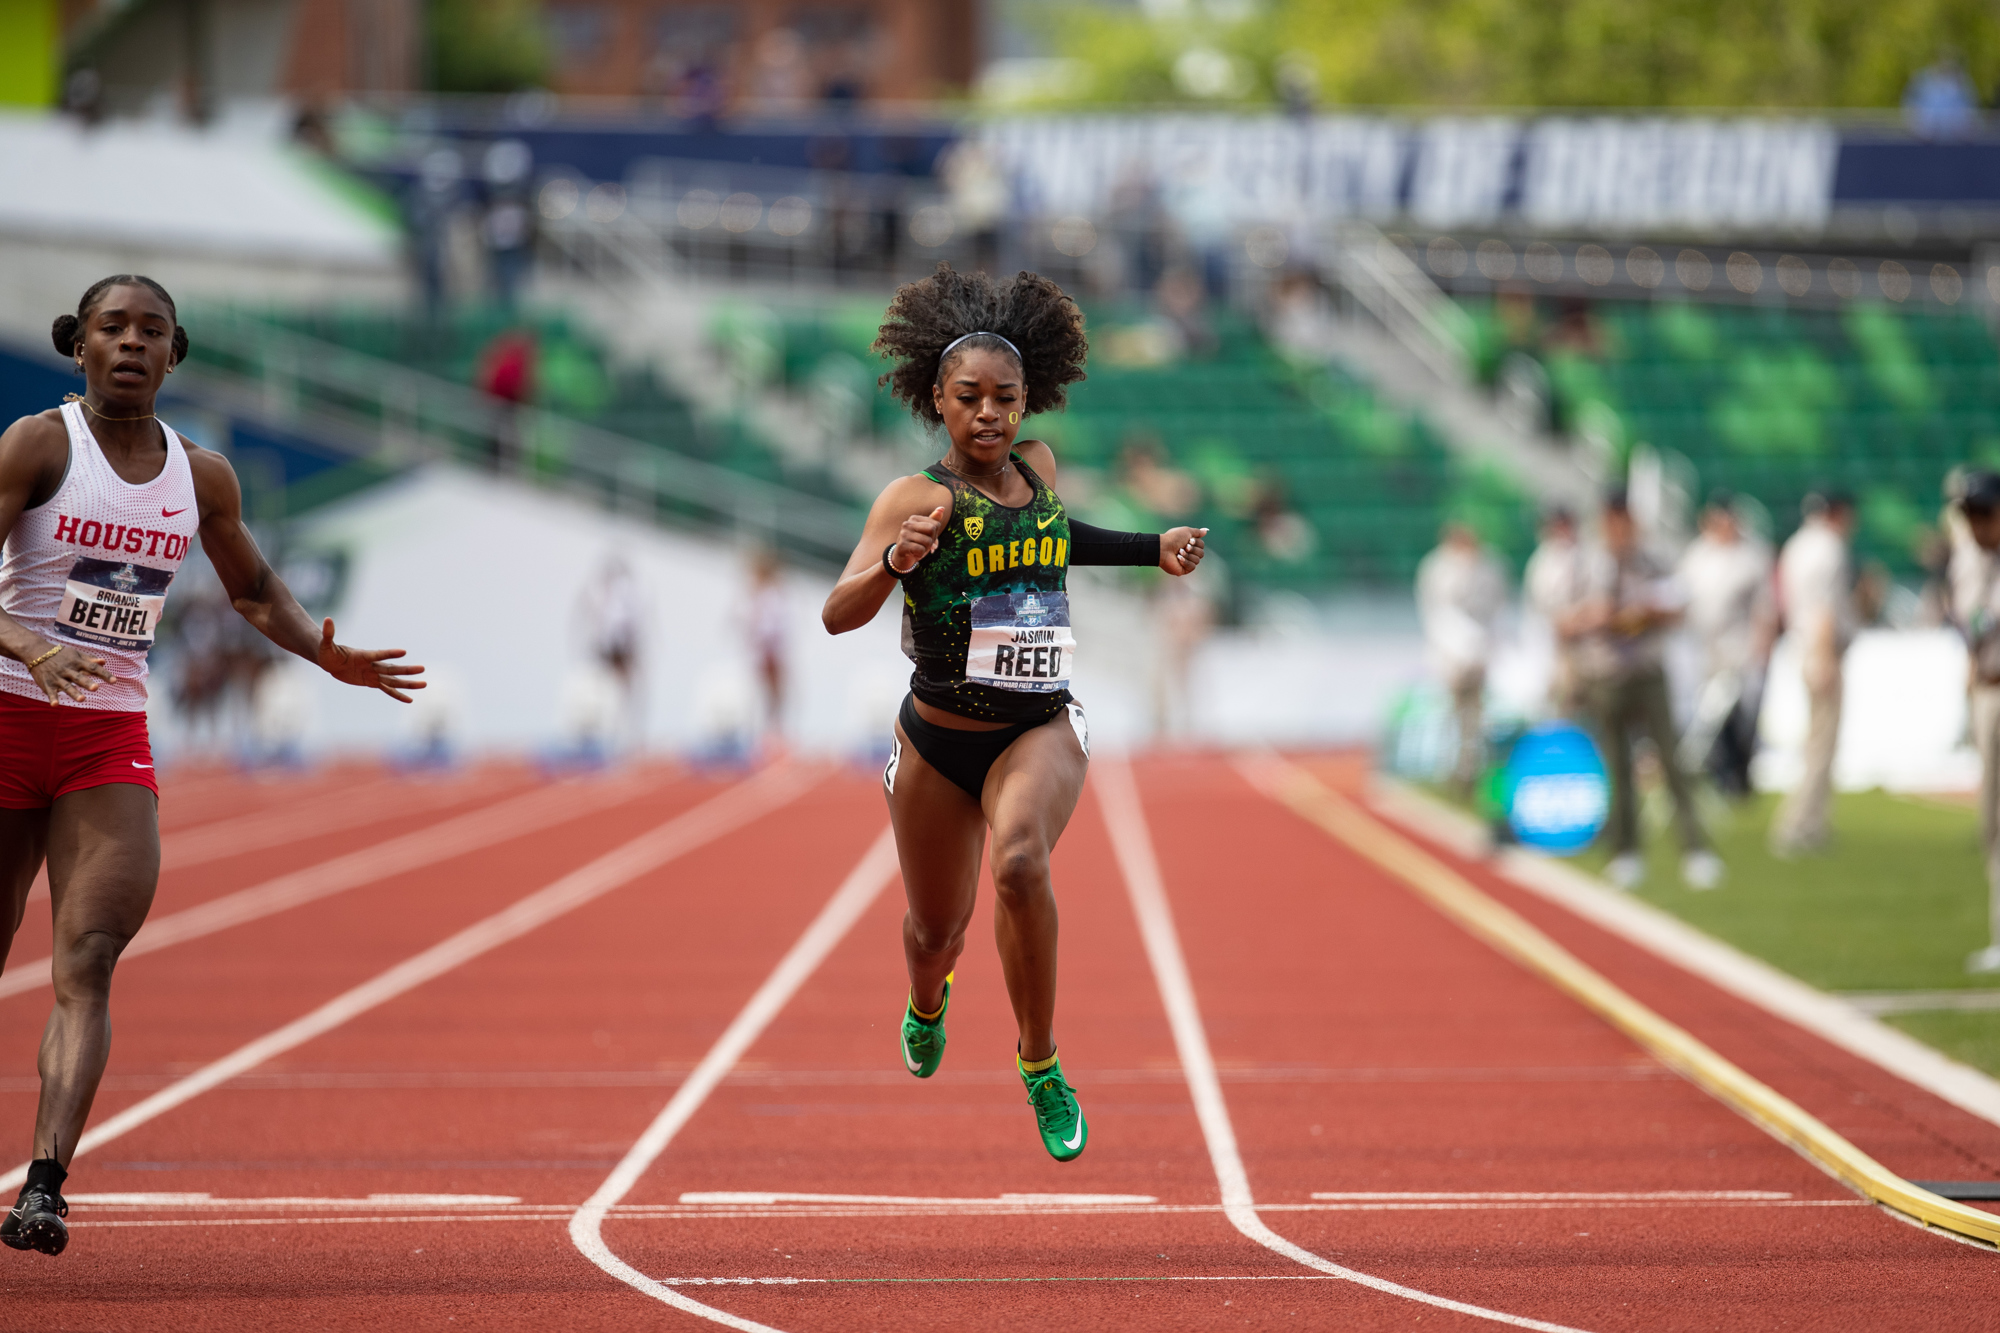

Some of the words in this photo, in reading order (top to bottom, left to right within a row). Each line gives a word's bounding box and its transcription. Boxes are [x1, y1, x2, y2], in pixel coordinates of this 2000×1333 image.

[54, 514, 192, 561] HOUSTON
[969, 526, 979, 536] 12
[967, 536, 1068, 577] OREGON
[96, 590, 141, 608] BRIANNE
[69, 598, 148, 636] BETHEL
[1011, 630, 1054, 644] JASMIN
[994, 644, 1063, 678] REED
[992, 680, 1018, 689] HAYWARD
[1018, 681, 1033, 689] FIELD
